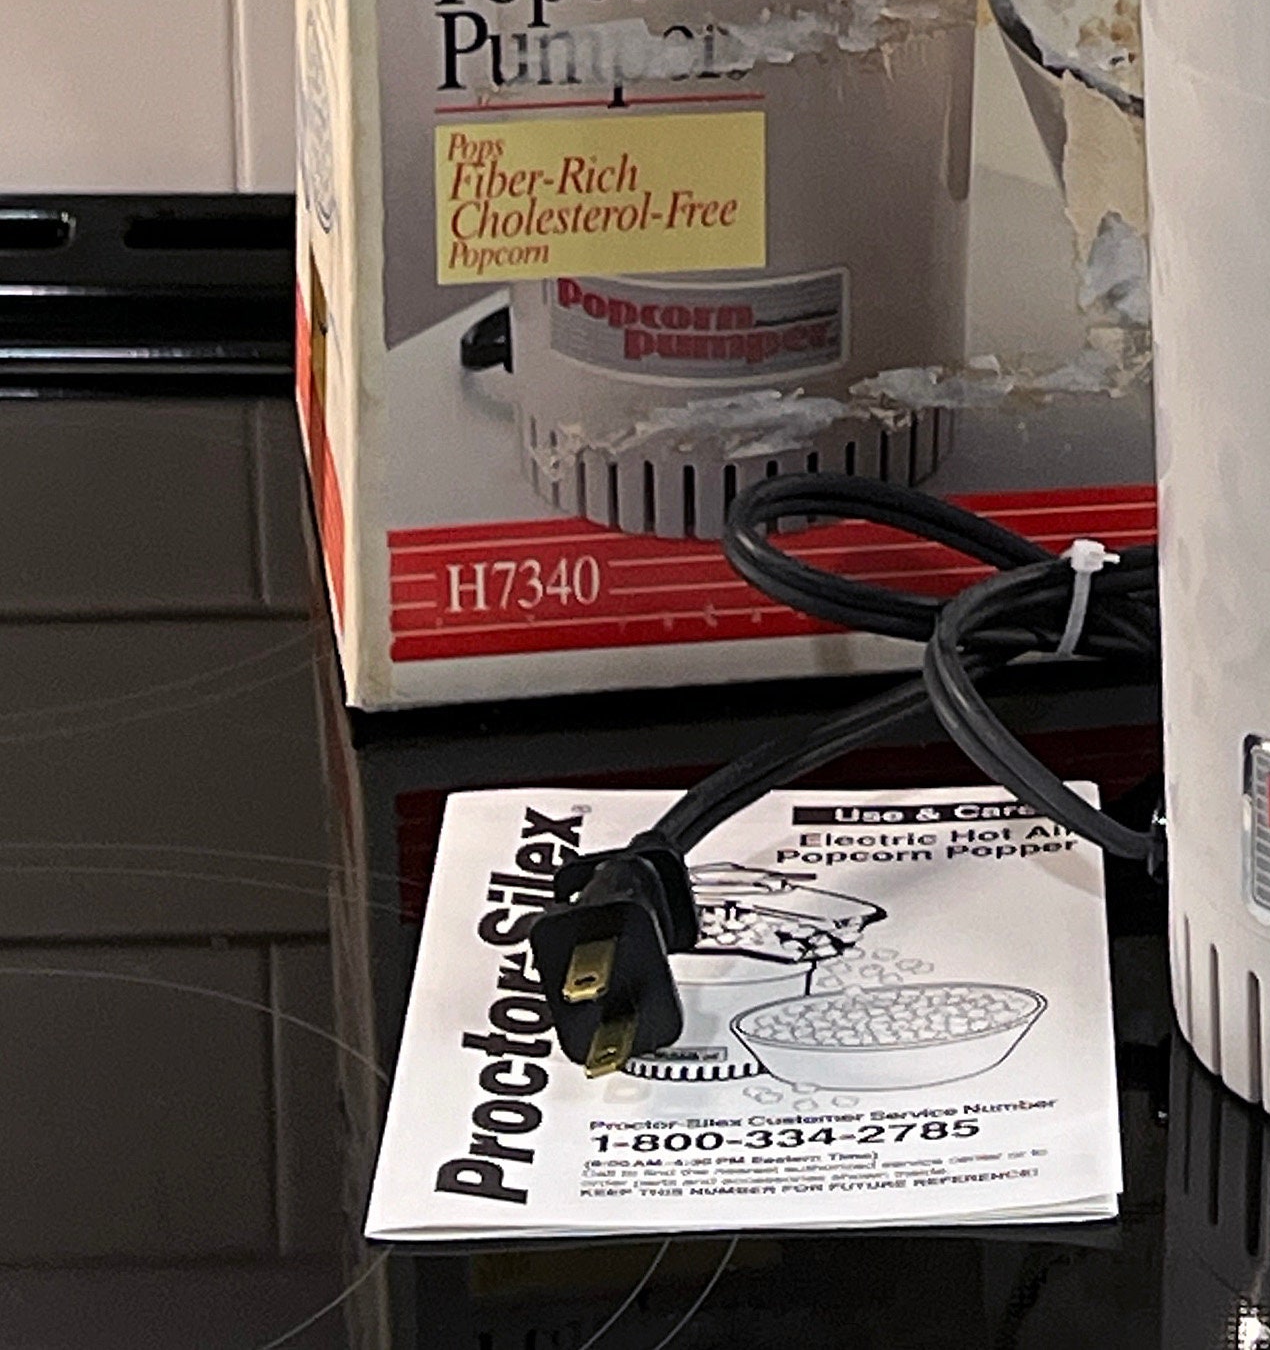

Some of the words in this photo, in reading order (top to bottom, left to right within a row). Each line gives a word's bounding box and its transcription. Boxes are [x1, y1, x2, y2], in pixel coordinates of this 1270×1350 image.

[448, 133, 505, 166] Pops
[450, 152, 639, 201] Fiber-Rich
[451, 191, 739, 240] Cholesterol-Free
[448, 241, 551, 275] Popcorn
[445, 555, 600, 615] H7340
[834, 806, 905, 823] Use
[915, 806, 941, 822] &
[777, 848, 933, 866] Popcorn
[947, 838, 1079, 858] Popper
[799, 831, 938, 848] Electric
[951, 827, 1012, 843] Hot
[591, 1118, 981, 1153] 1-800-334-2785
